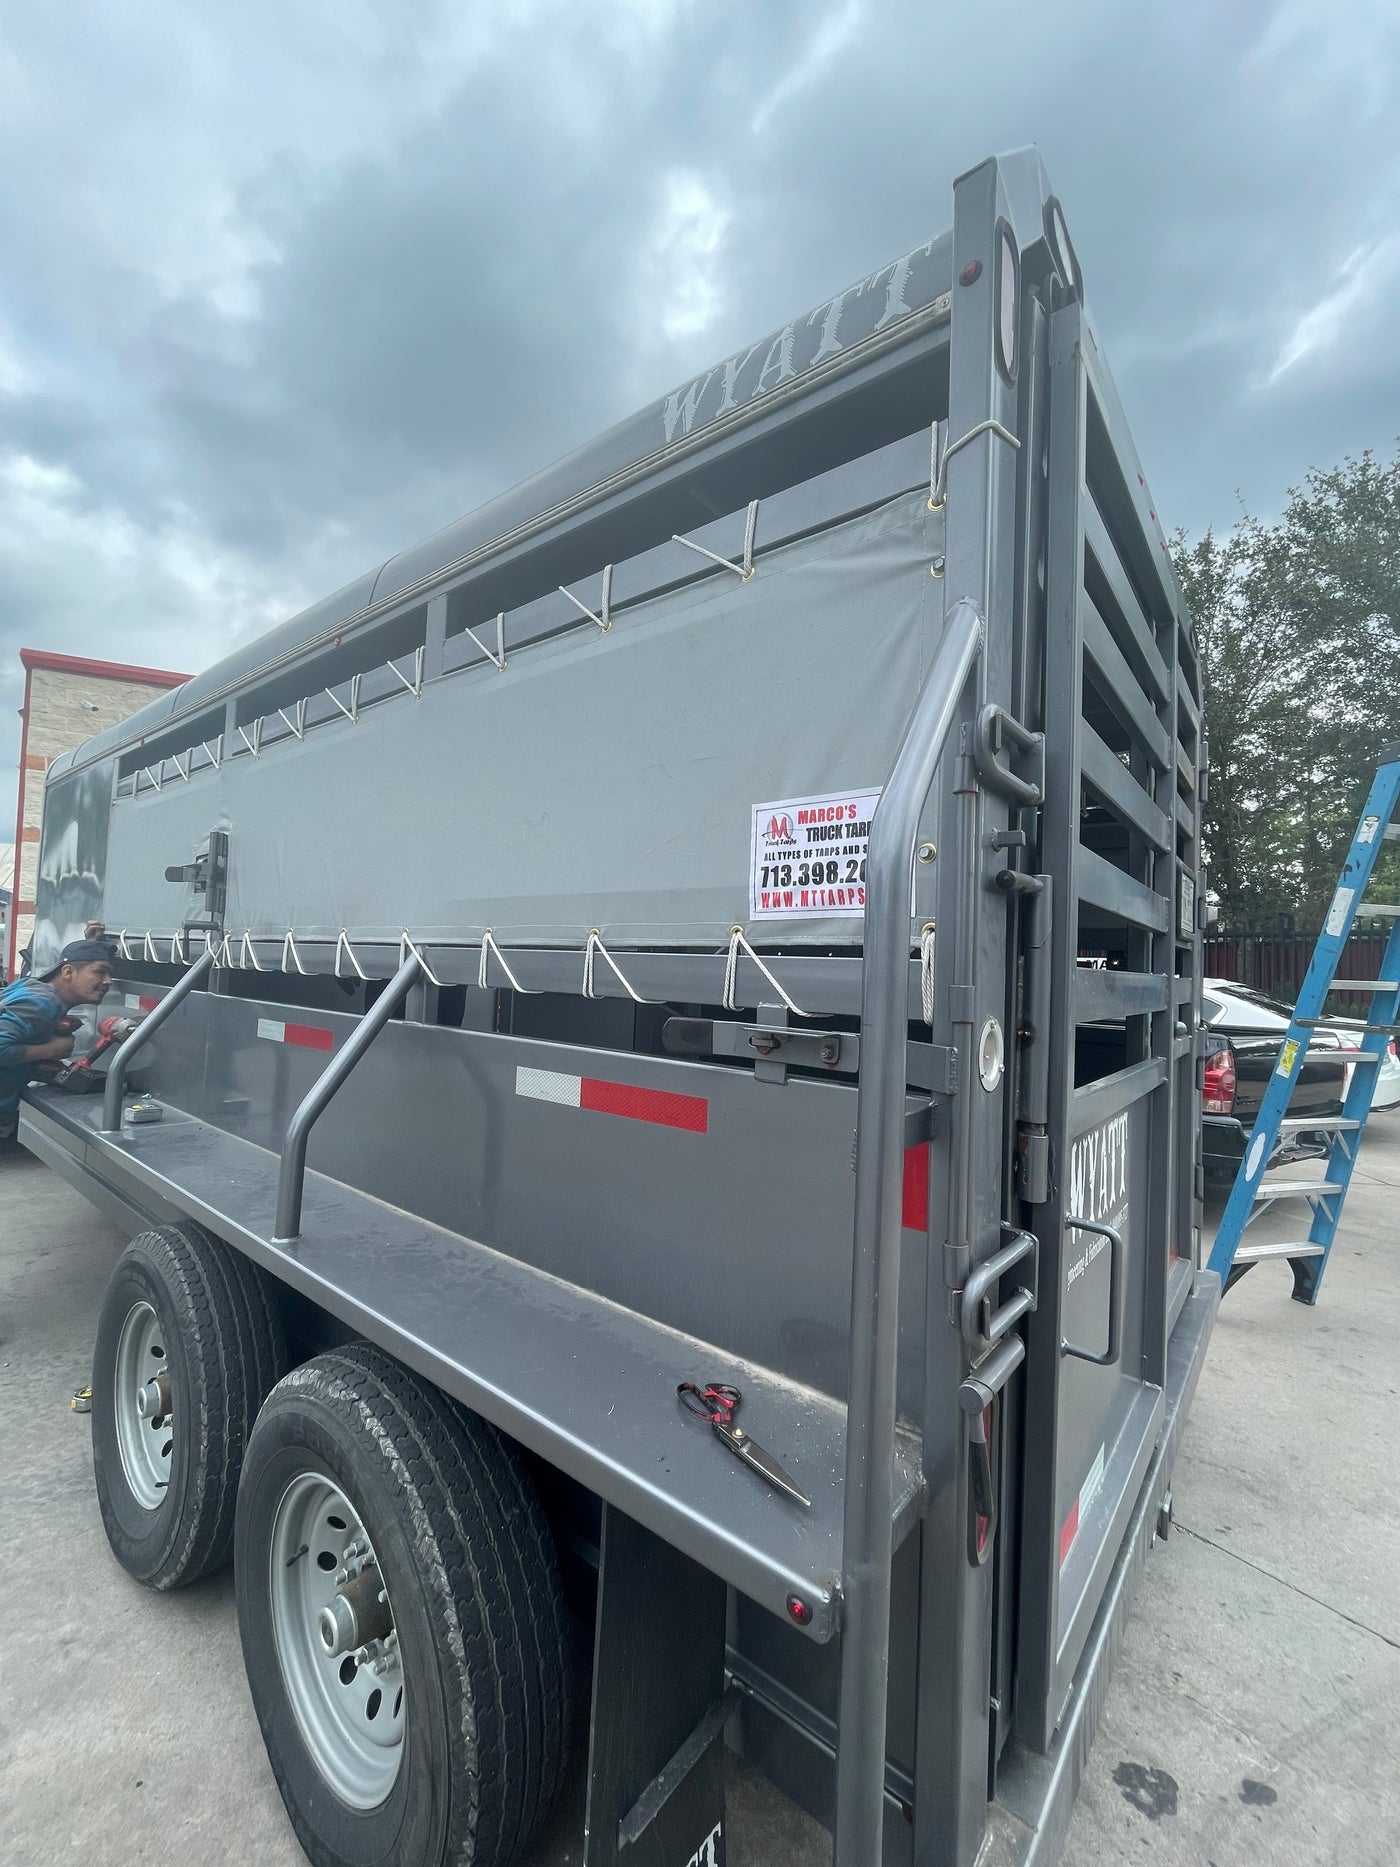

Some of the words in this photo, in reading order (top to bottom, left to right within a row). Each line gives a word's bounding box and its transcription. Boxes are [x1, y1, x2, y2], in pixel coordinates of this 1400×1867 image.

[660, 236, 938, 442] WYATT
[798, 804, 857, 824] MARCO'S
[806, 824, 843, 842] TRUCK
[764, 852, 775, 861] ALL
[778, 850, 801, 860] TYPES
[803, 849, 813, 858] OF
[815, 847, 840, 857] TARPS
[843, 845, 860, 855] AND
[1071, 1112, 1128, 1244] WYATT
